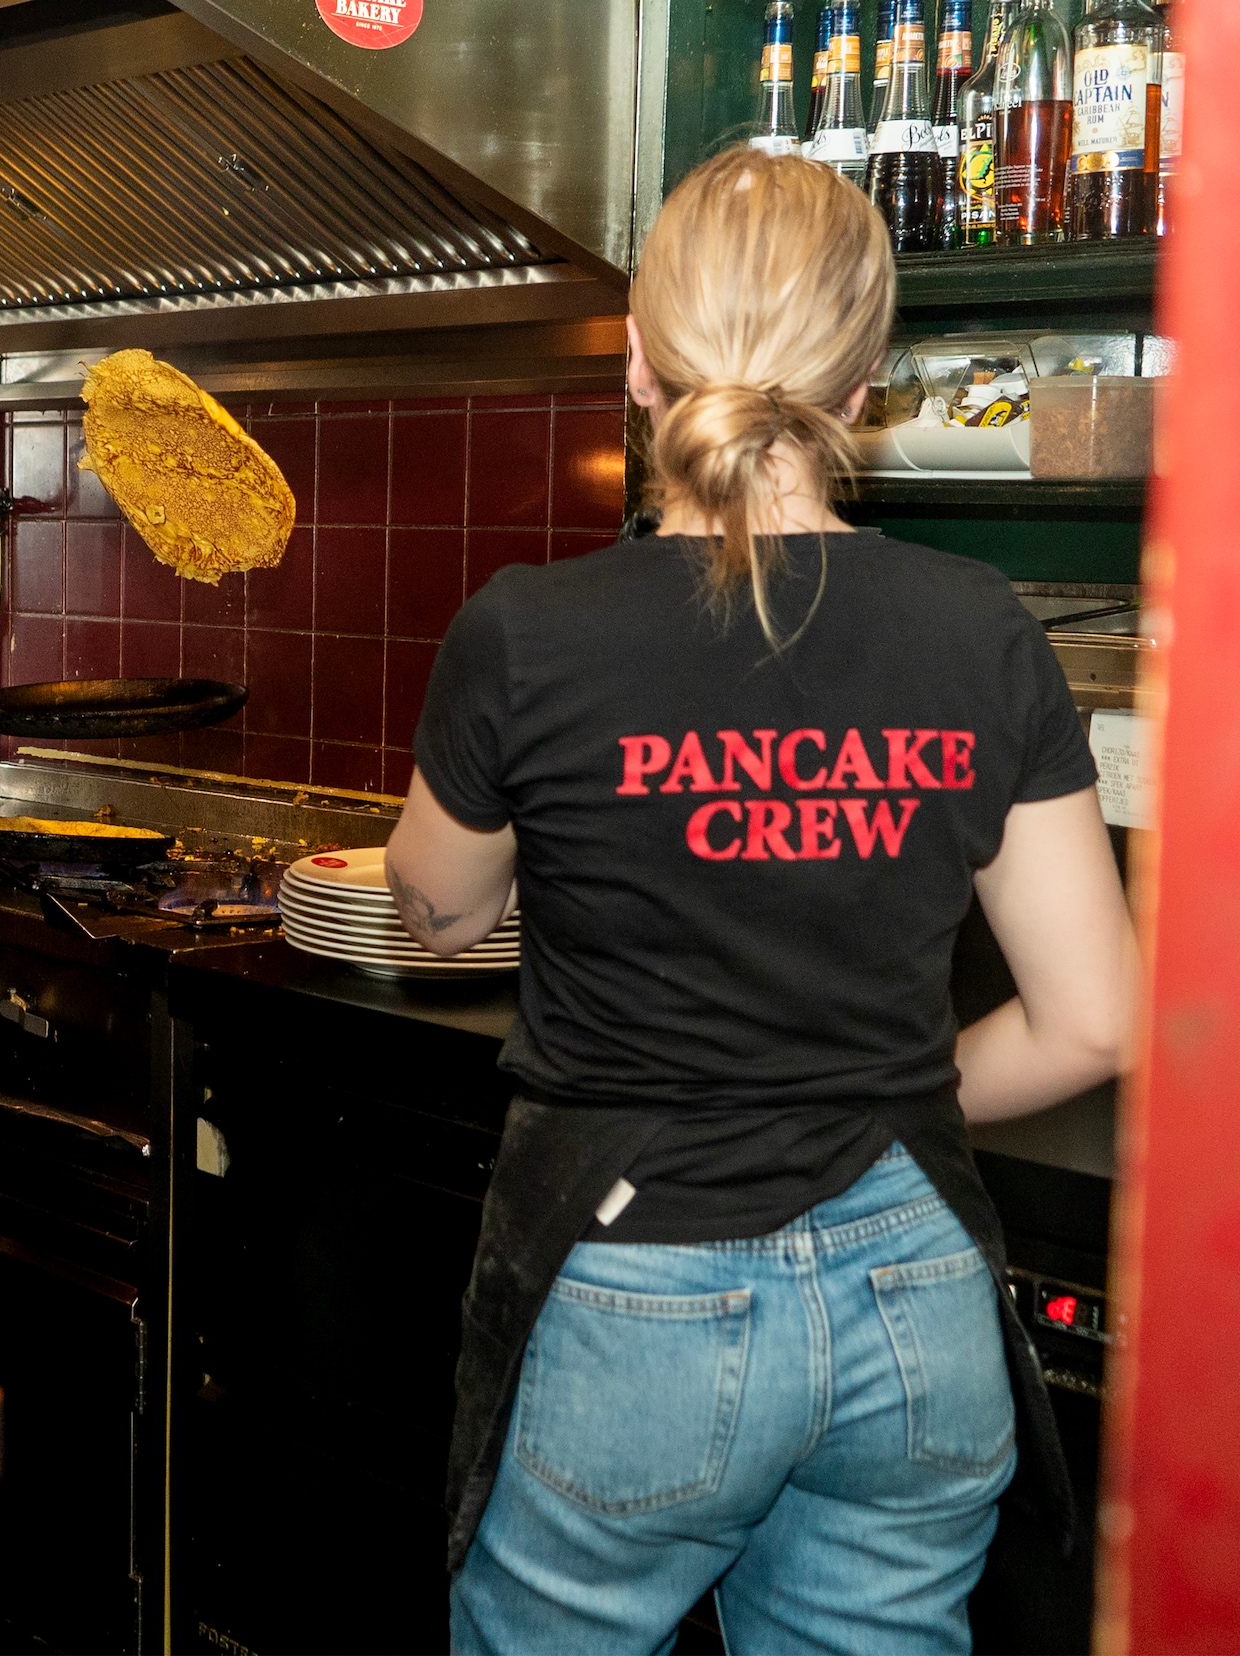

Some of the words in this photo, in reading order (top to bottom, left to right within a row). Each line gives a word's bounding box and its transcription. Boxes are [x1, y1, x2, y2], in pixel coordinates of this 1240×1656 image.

[335, 0, 402, 24] BAKERY
[1084, 69, 1109, 87] OLD
[1087, 114, 1105, 125] RUM
[901, 119, 934, 154] Bols
[615, 727, 976, 796] PANCAKE
[685, 798, 921, 862] CREW
